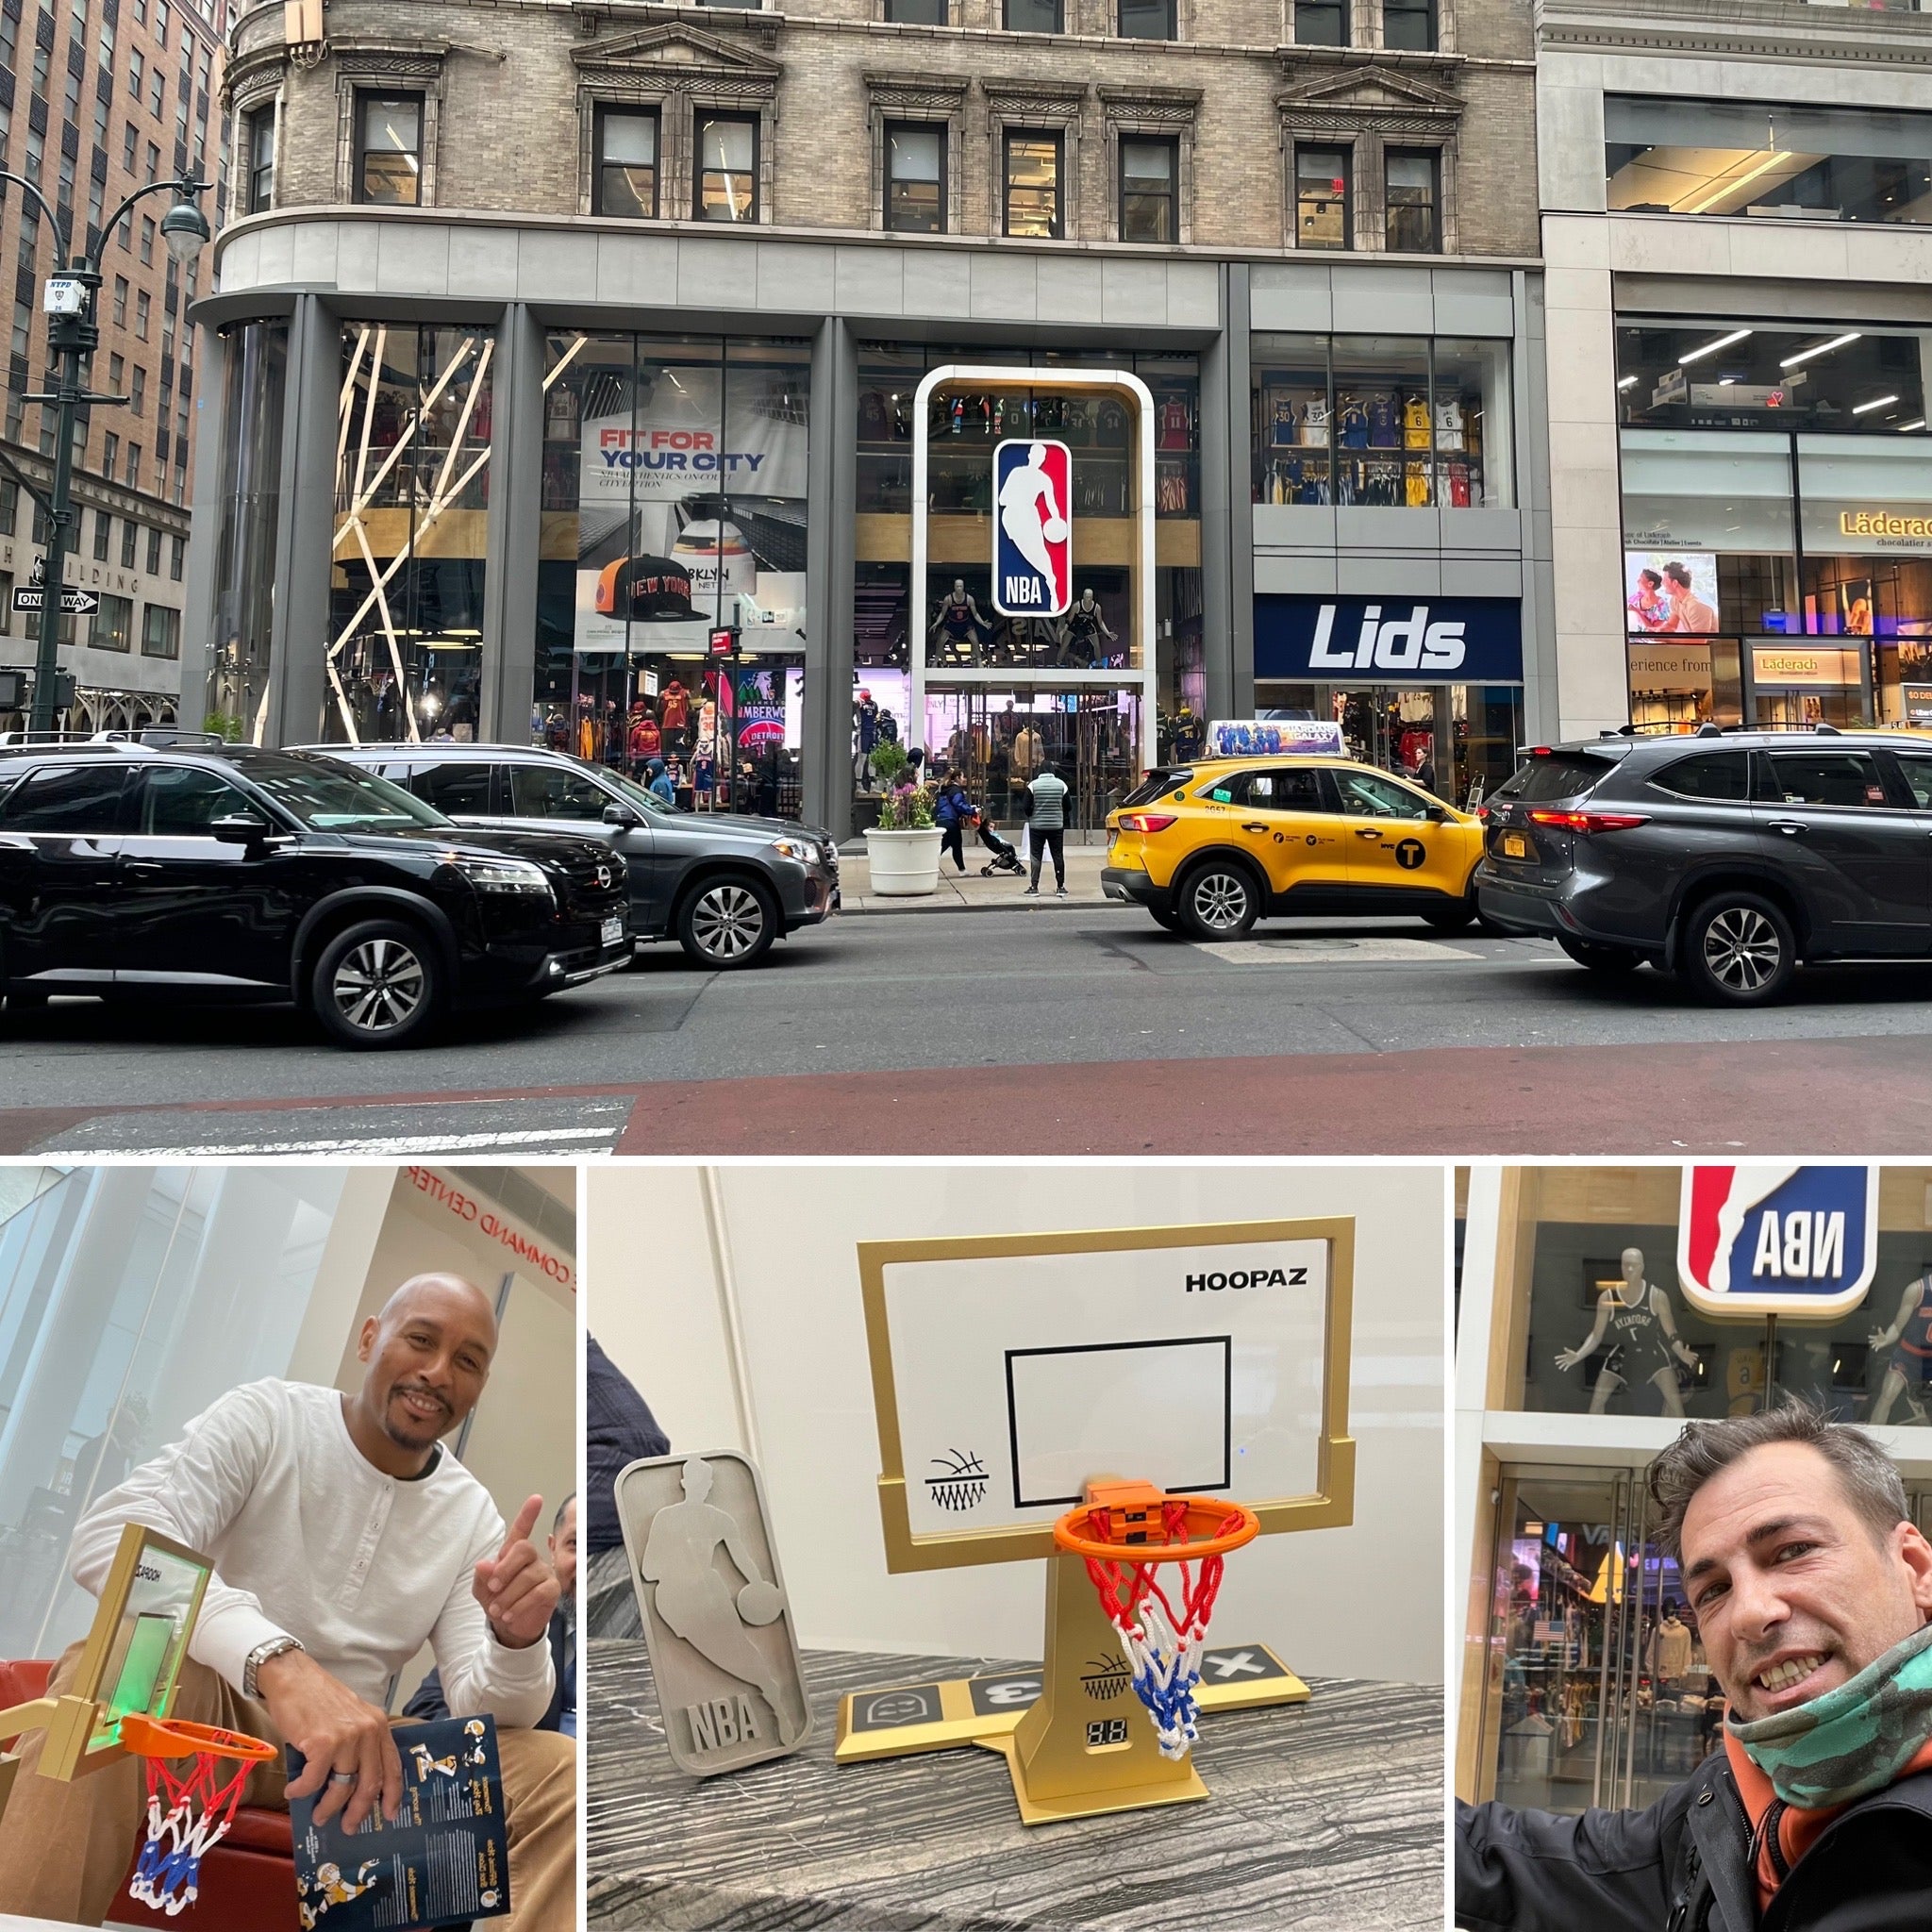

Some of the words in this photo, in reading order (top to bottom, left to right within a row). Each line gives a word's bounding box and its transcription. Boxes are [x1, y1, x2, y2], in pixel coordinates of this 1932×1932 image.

[1278, 410, 1291, 423] 30
[1415, 416, 1422, 426] 6
[1445, 417, 1453, 427] 6
[600, 429, 646, 448] FIT
[651, 431, 714, 450] FOR
[600, 450, 688, 471] YOUR
[691, 453, 765, 472] CITY
[1842, 512, 1932, 536] Läderac
[1876, 539, 1924, 547] chocolatier
[67, 561, 140, 592] ILDING
[1006, 575, 1042, 604] NBA
[63, 596, 90, 607] WAY
[1308, 605, 1466, 670] Lids
[1630, 658, 1677, 672] erience
[1762, 658, 1818, 670] Läderach
[667, 700, 677, 709] 45
[1294, 732, 1335, 741] GALAXY
[1403, 844, 1419, 865] T
[1186, 1268, 1307, 1292] HOOPAZ
[686, 1692, 762, 1754] NBA
